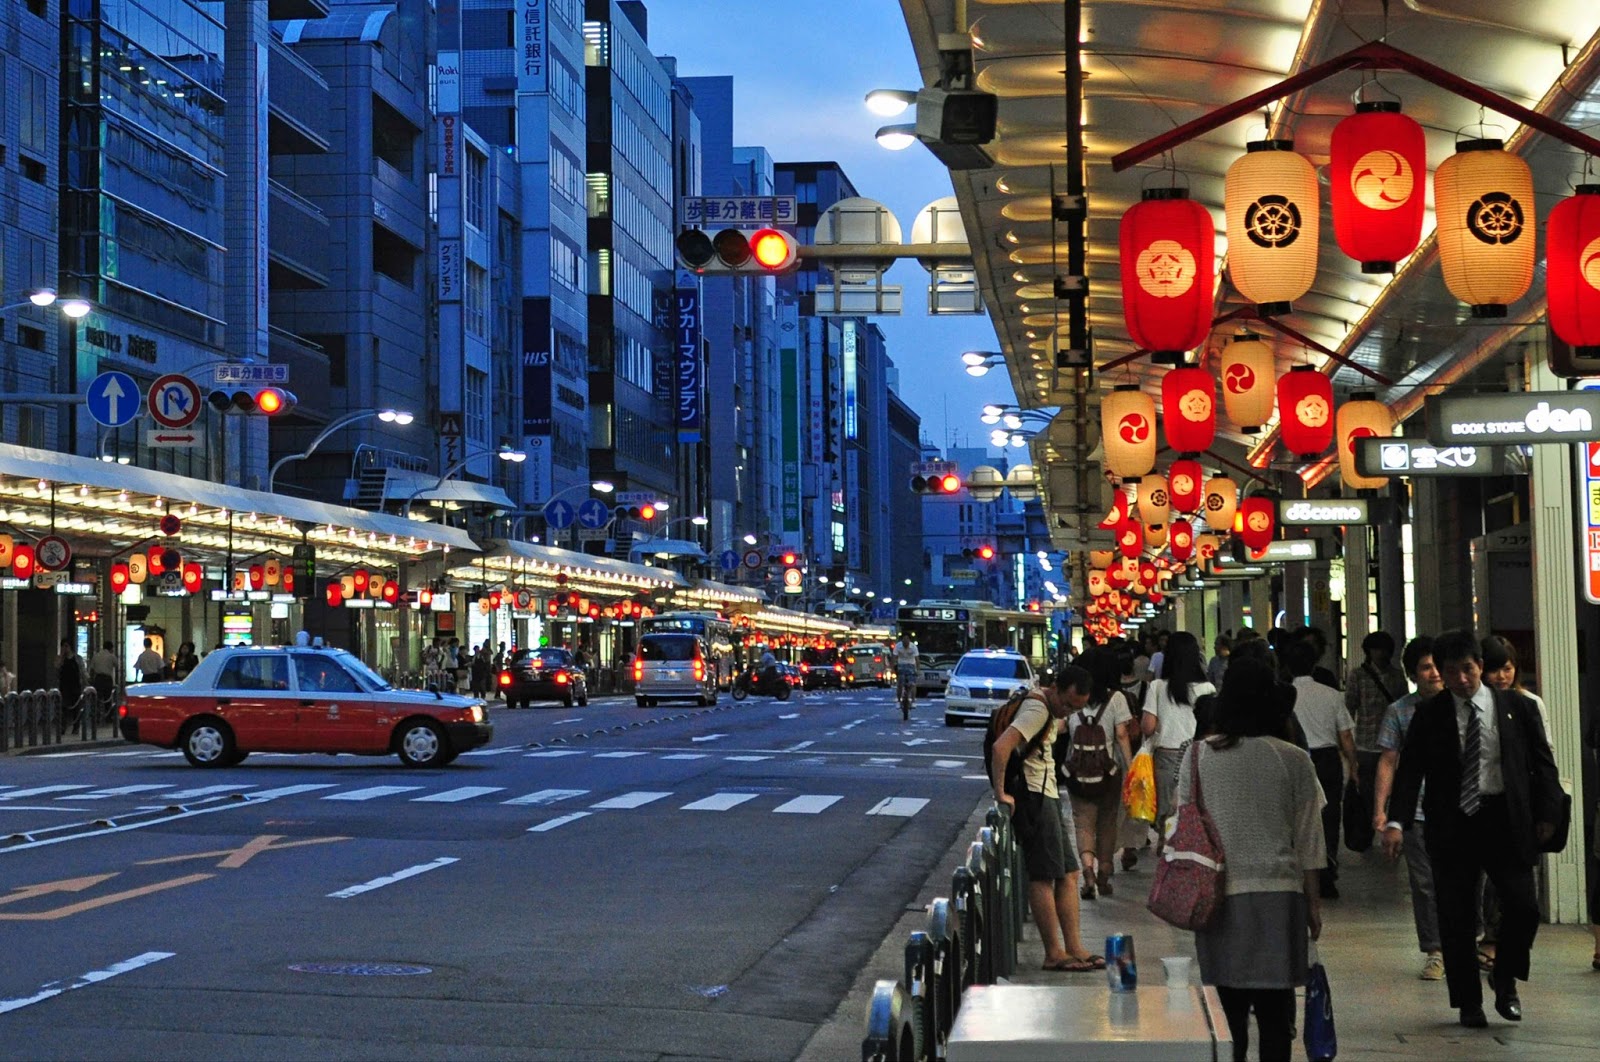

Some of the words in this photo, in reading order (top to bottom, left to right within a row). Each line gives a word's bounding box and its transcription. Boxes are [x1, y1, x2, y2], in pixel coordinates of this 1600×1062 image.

[687, 201, 792, 219] 歩車分離信号
[679, 297, 696, 422] リカーマウンテン
[218, 366, 286, 379] 歩車分離信号
[1451, 423, 1486, 435] BOOK
[1487, 421, 1526, 433] STORE
[1411, 446, 1477, 468] 宝くじ
[682, 620, 692, 629] 3
